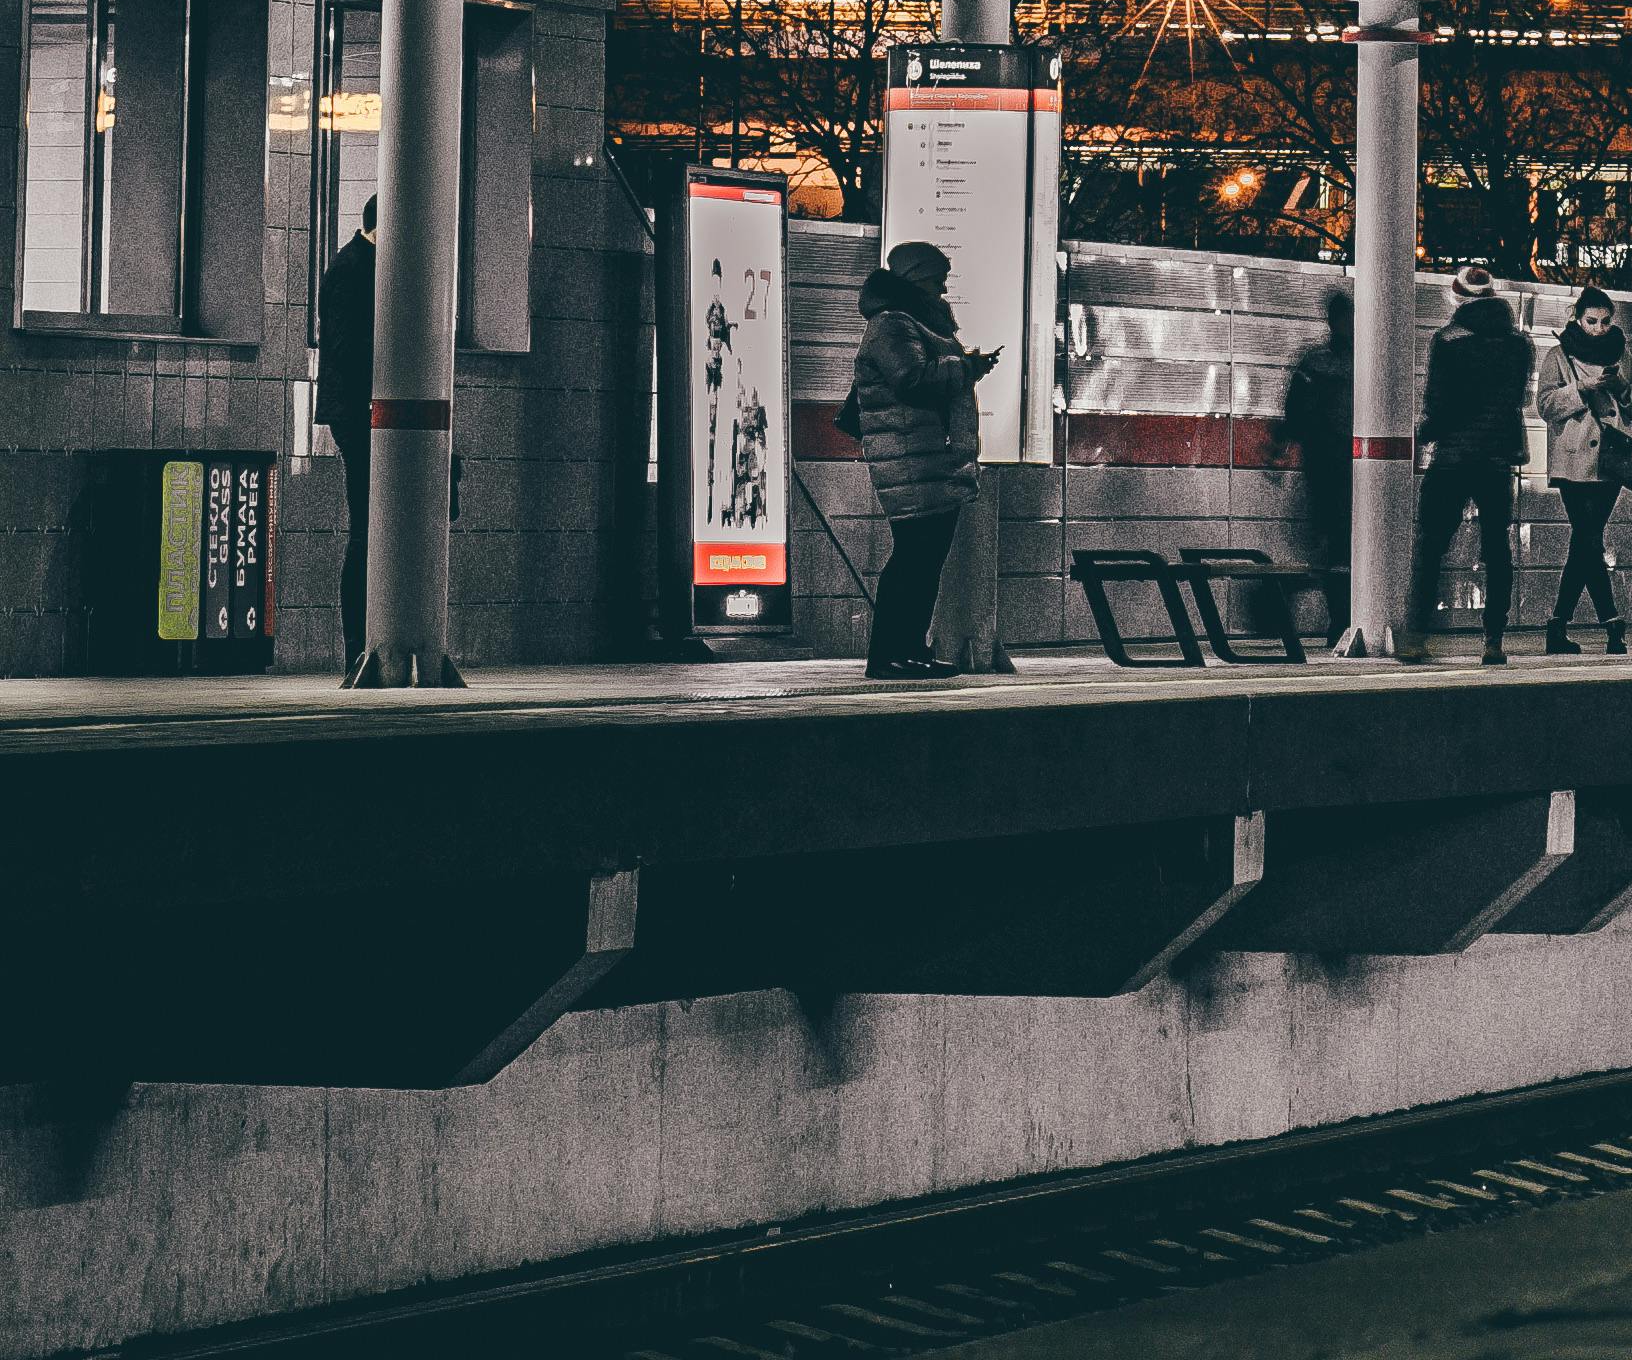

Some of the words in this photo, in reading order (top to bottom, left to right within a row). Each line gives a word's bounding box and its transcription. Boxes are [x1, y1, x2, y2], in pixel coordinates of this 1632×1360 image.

[744, 268, 771, 320] 27
[166, 464, 190, 613] ПЛАСТИК
[208, 468, 219, 589] СТЕКЛО
[219, 469, 231, 564] GLASS
[236, 469, 248, 587] БУМАГА
[248, 470, 259, 564] PAPER
